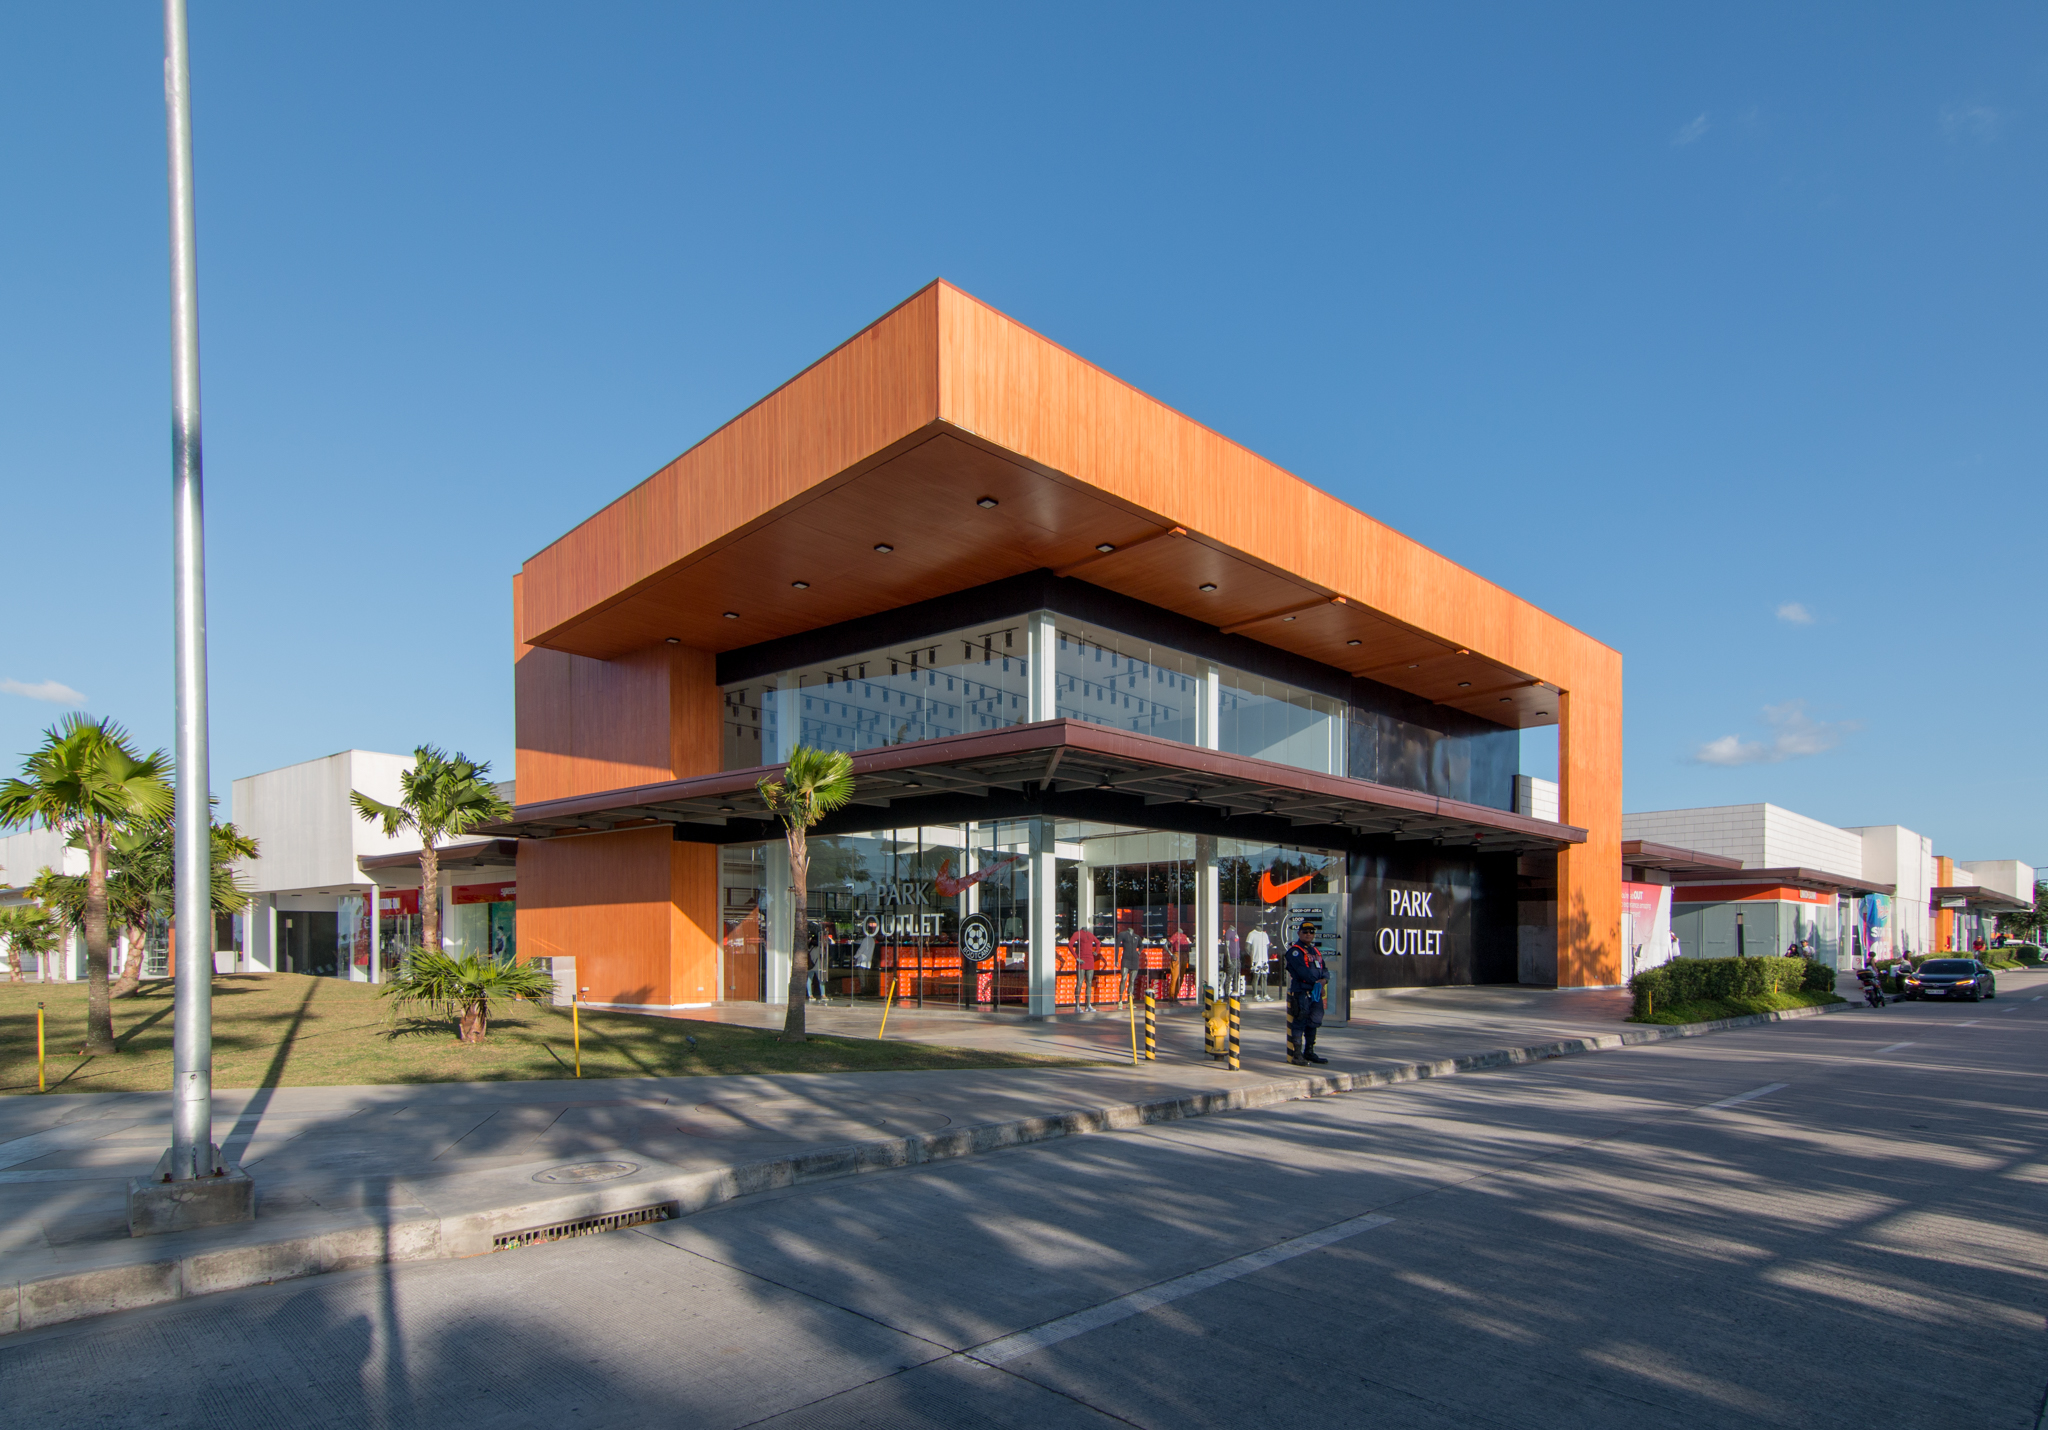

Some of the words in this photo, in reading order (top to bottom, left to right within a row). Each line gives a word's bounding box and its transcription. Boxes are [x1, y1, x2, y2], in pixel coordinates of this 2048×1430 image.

[876, 882, 930, 906] PARK
[1390, 889, 1433, 917] PARK
[863, 913, 945, 937] OUTLET
[962, 942, 992, 959] BOOTCAMP
[1379, 927, 1443, 955] OUTLET
